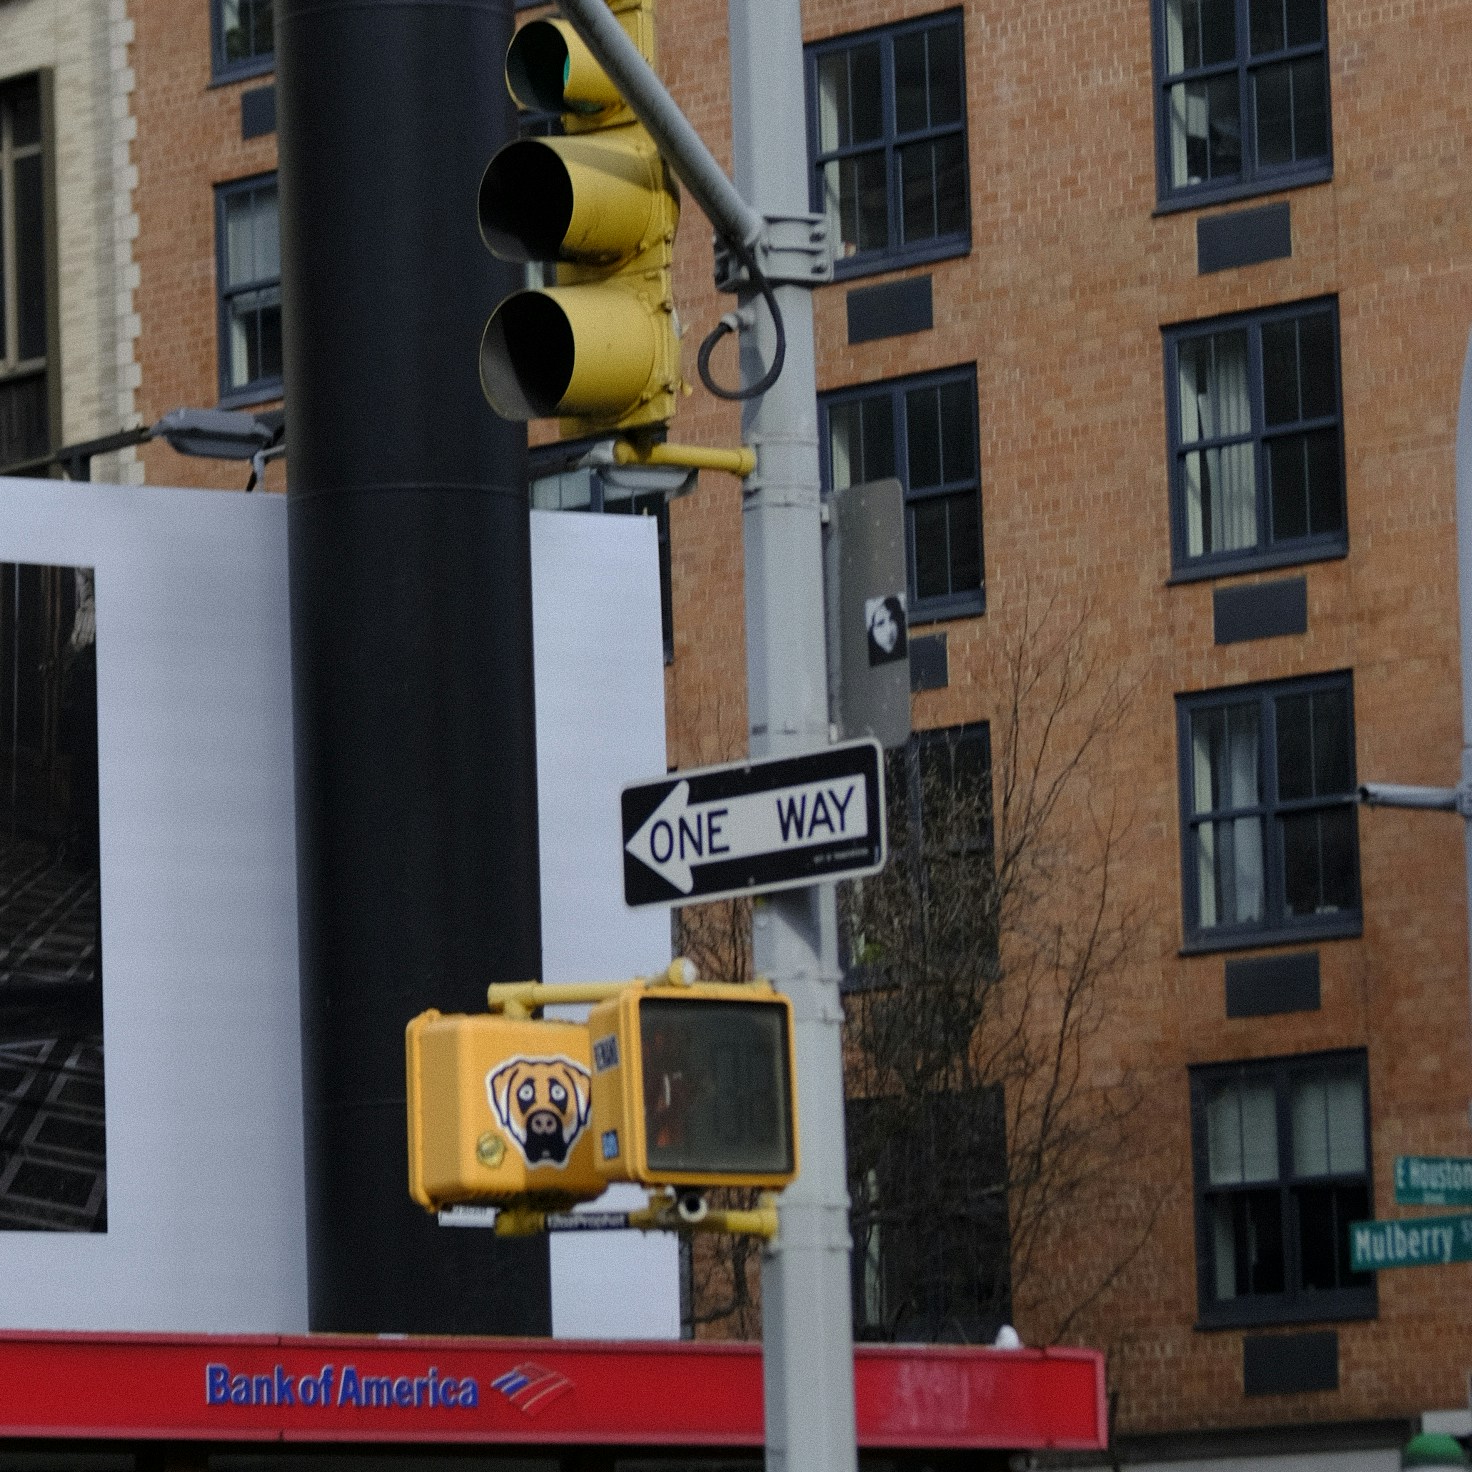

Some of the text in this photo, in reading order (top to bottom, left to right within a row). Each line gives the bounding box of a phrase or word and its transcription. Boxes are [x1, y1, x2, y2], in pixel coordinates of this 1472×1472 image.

[650, 786, 856, 865] ONE WAY
[1355, 1222, 1453, 1263] Mulberry
[205, 1362, 478, 1409] Bank of America
